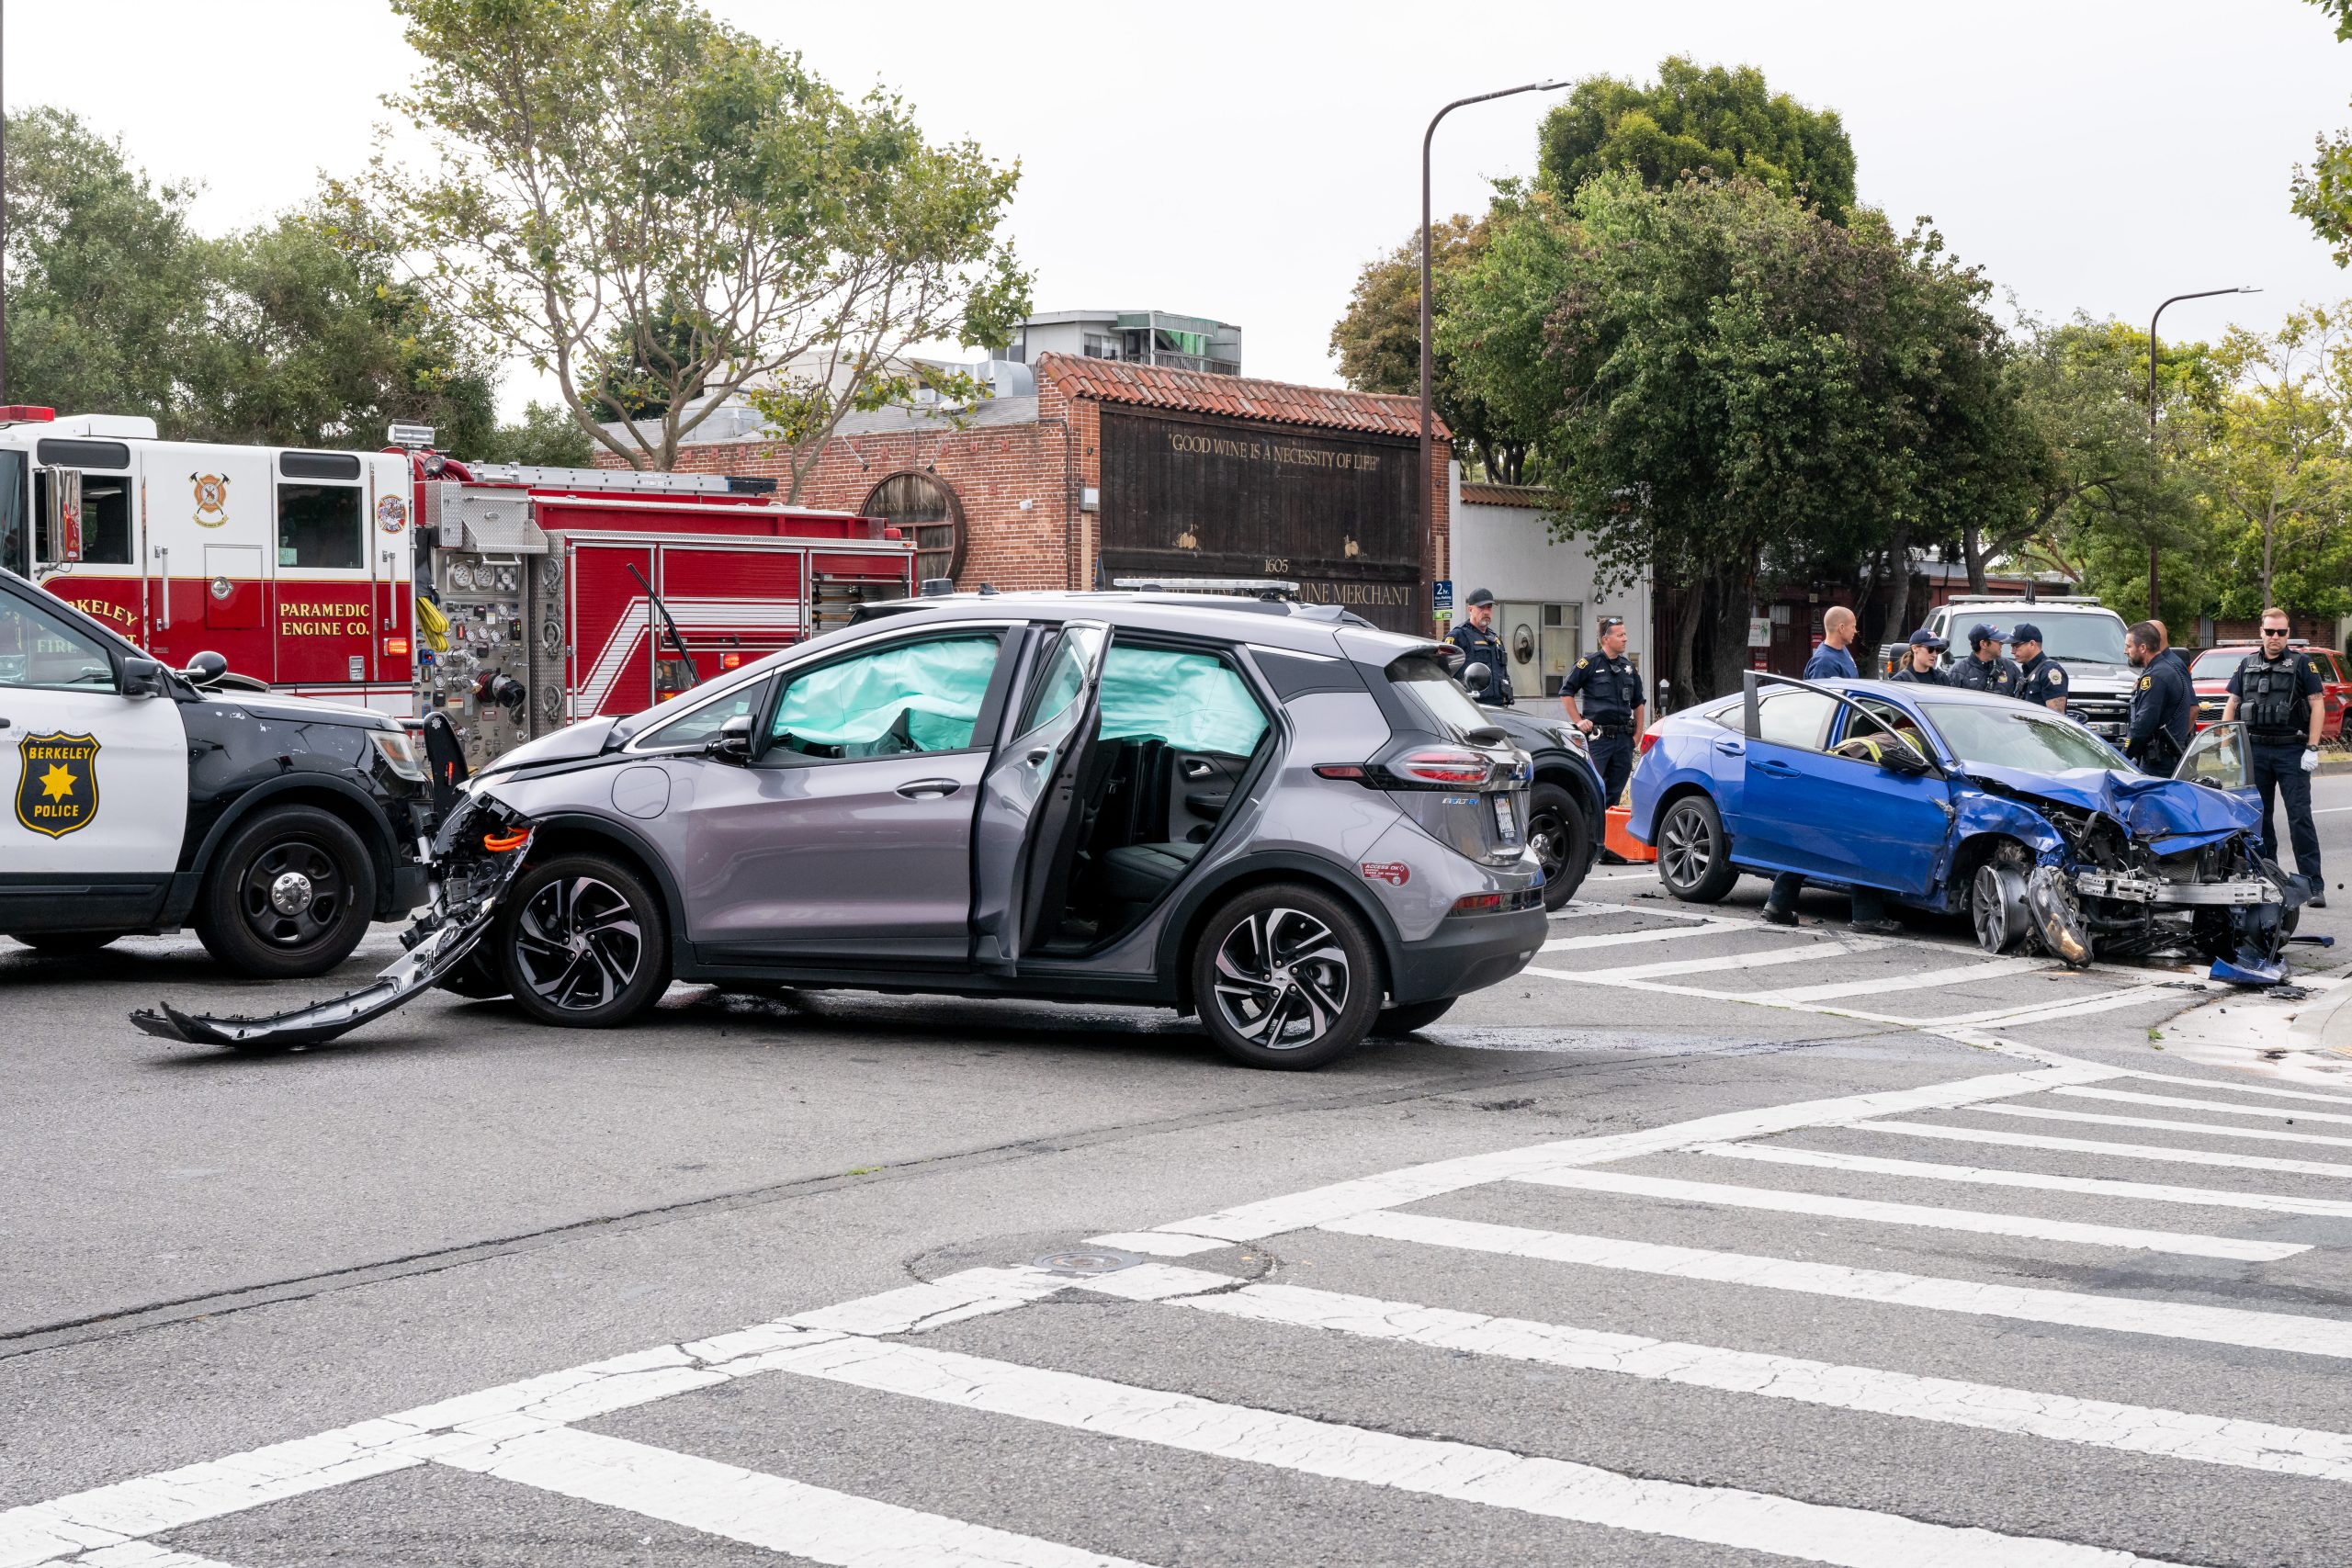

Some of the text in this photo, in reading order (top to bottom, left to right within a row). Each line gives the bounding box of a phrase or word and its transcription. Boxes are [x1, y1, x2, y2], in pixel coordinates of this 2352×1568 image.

[1213, 438, 1248, 458] WINE
[1250, 443, 1261, 459] IS
[1262, 445, 1271, 460] A
[1273, 446, 1336, 468] NECESSITY
[1337, 452, 1351, 468] OF
[1264, 558, 1288, 573] 1605
[1333, 584, 1412, 606] MERCHANT
[1436, 582, 1443, 595] 2
[279, 604, 370, 617] PARAMEDIC
[281, 622, 370, 636] ENGINE CO.
[28, 747, 91, 760] BERKELEY
[34, 805, 79, 818] POLICE
